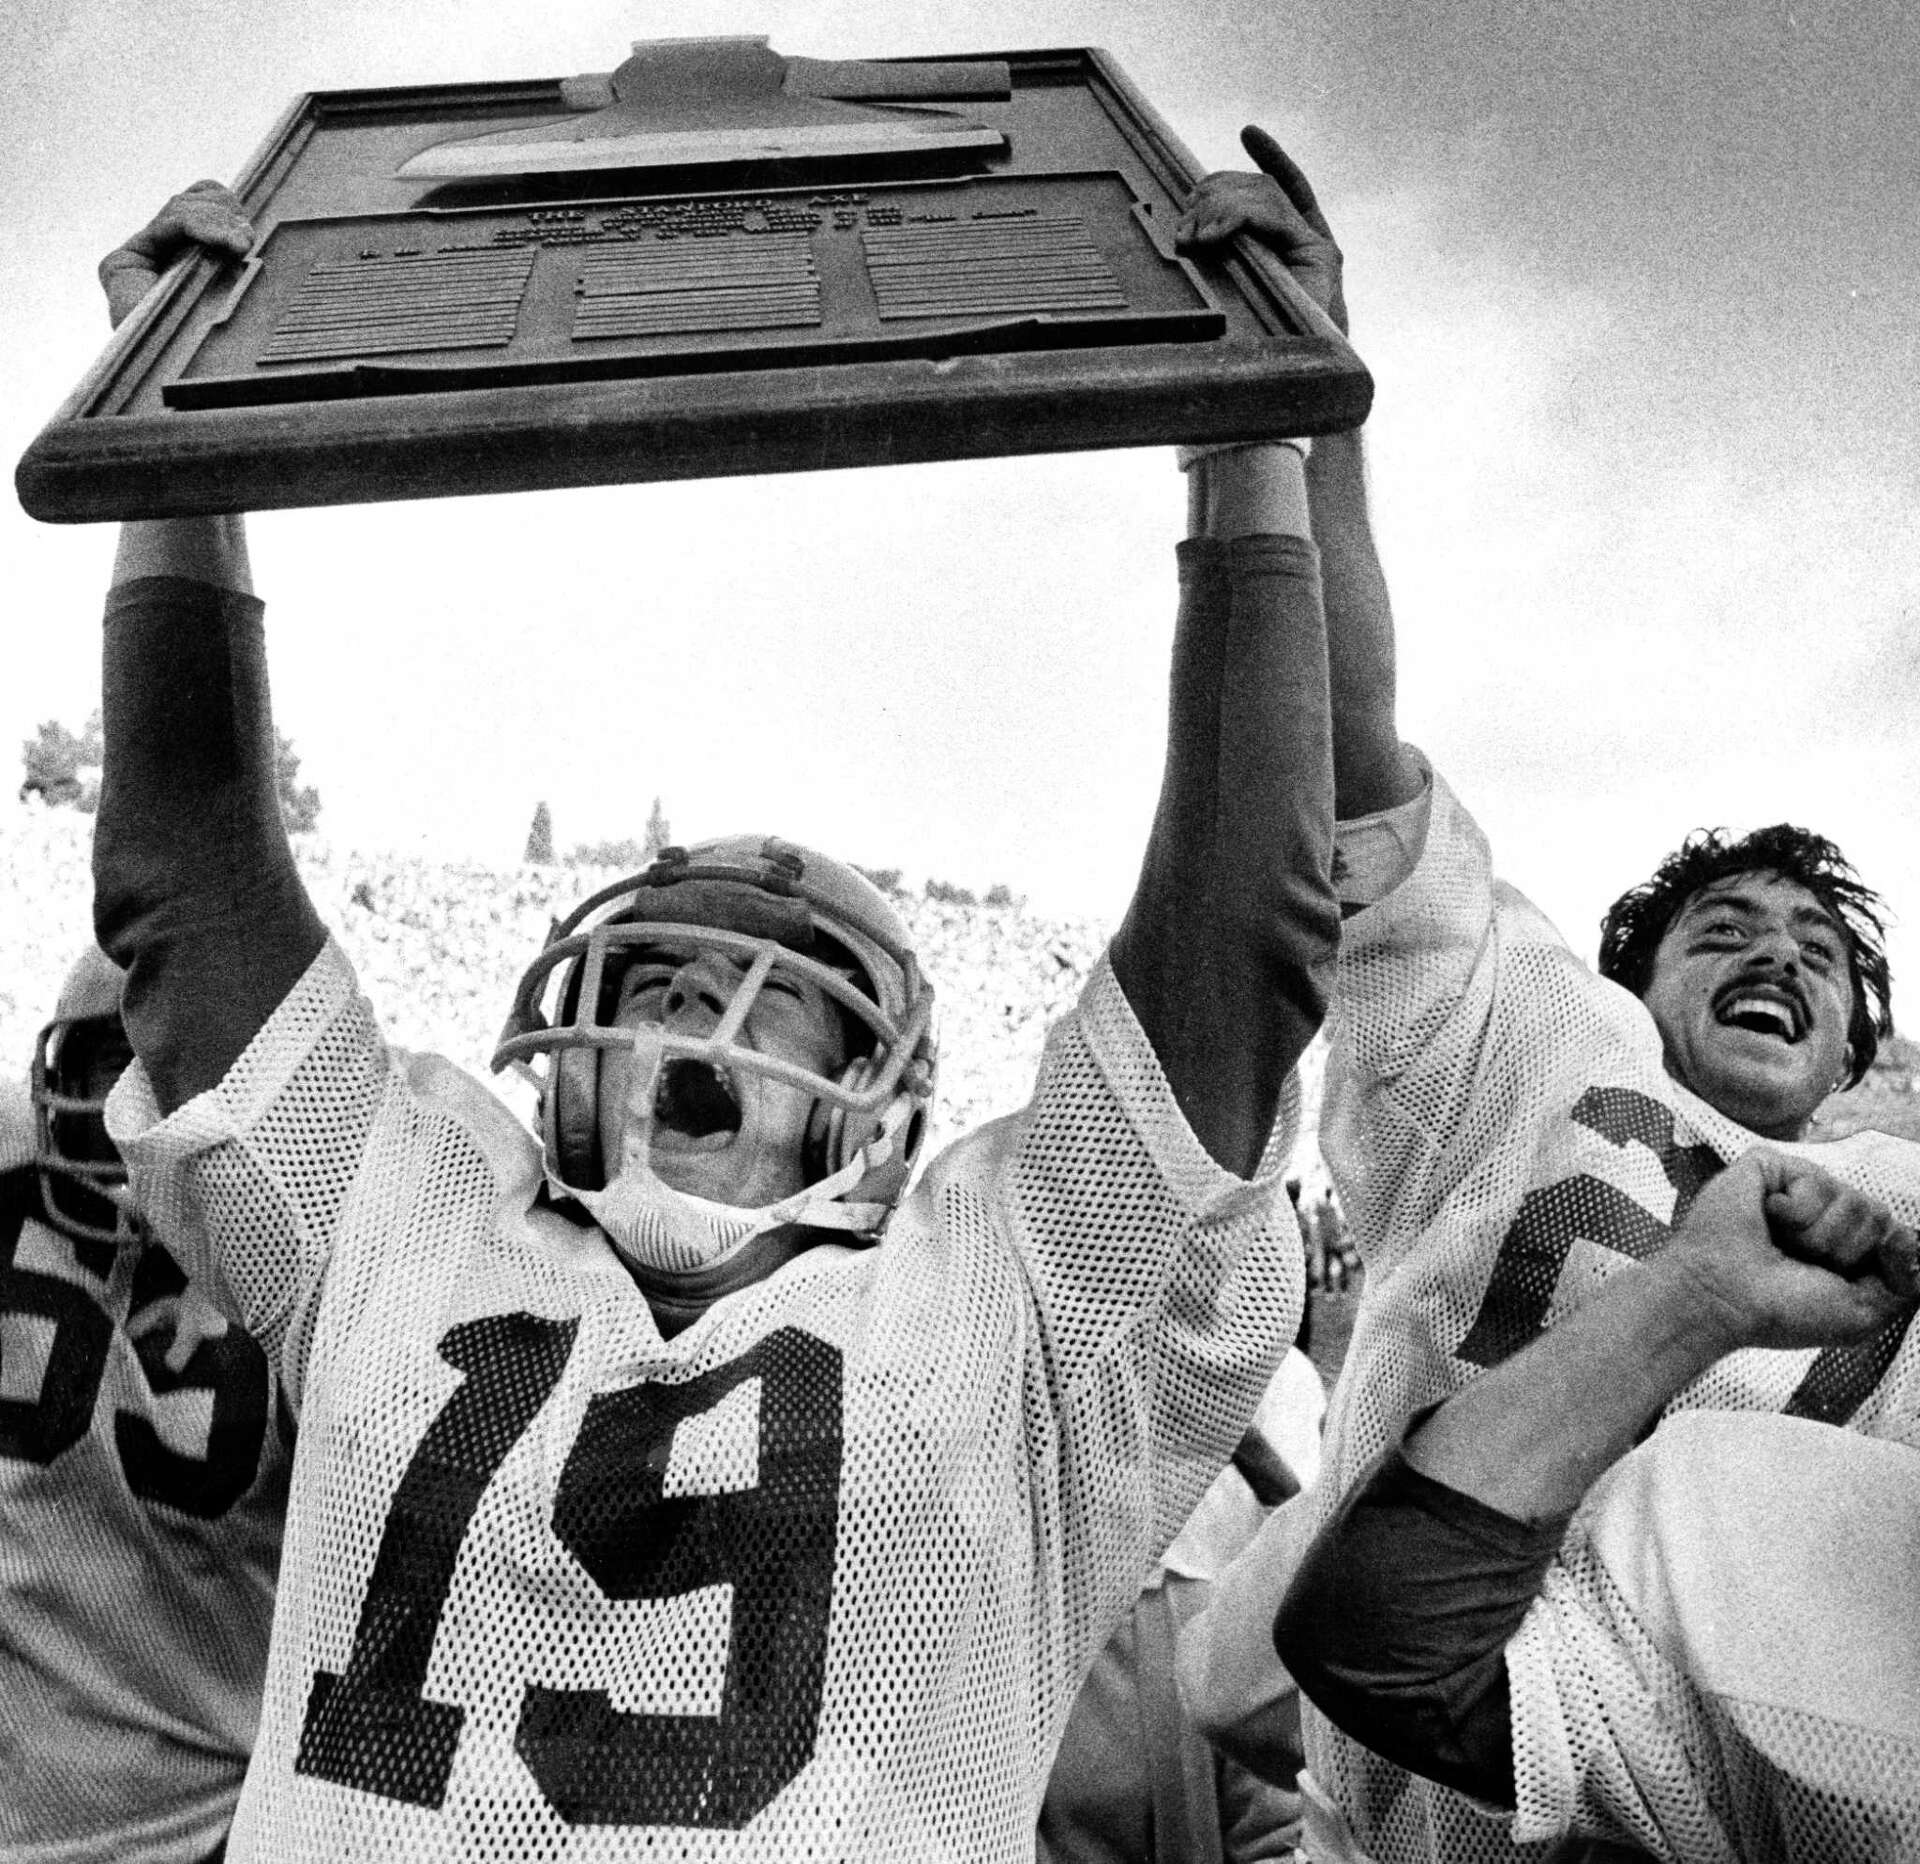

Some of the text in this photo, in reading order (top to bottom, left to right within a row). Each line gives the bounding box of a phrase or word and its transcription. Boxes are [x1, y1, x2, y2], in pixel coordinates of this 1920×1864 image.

[529, 193, 868, 223] THE STANFORD AXE
[296, 1311, 844, 1830] 19
